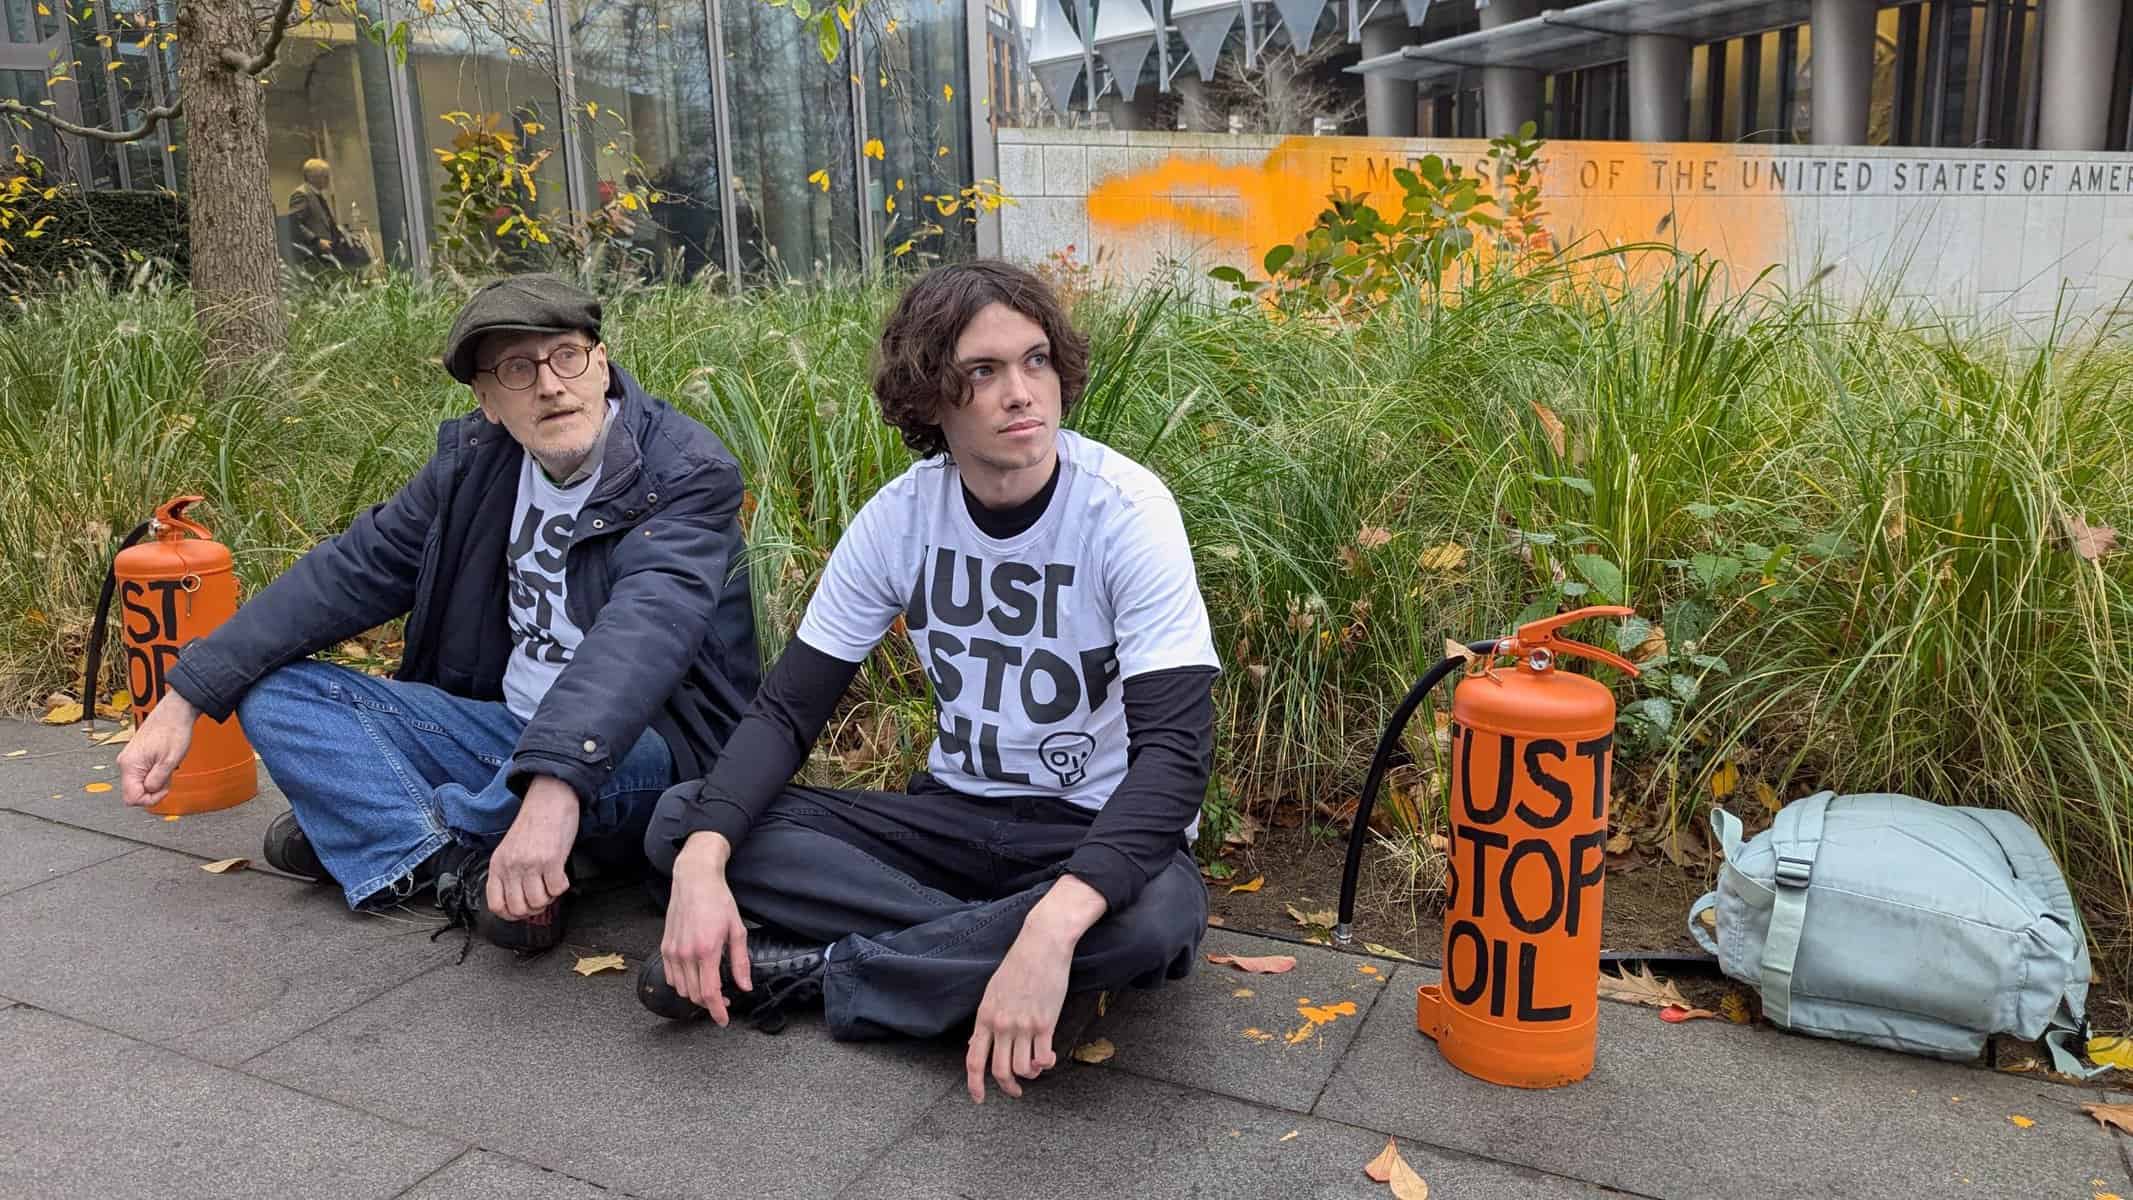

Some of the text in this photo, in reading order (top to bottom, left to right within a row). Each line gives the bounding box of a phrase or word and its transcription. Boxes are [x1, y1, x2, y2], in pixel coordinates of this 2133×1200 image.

[1331, 156, 1549, 194] EMSY
[1580, 160, 1625, 190] OF
[1651, 160, 1718, 191] THE
[1743, 160, 1873, 192] UNITED
[1894, 162, 2006, 192] STATES
[2024, 164, 2053, 192] OF
[928, 630, 1119, 724] STOP
[1447, 920, 1572, 1022] OIL
